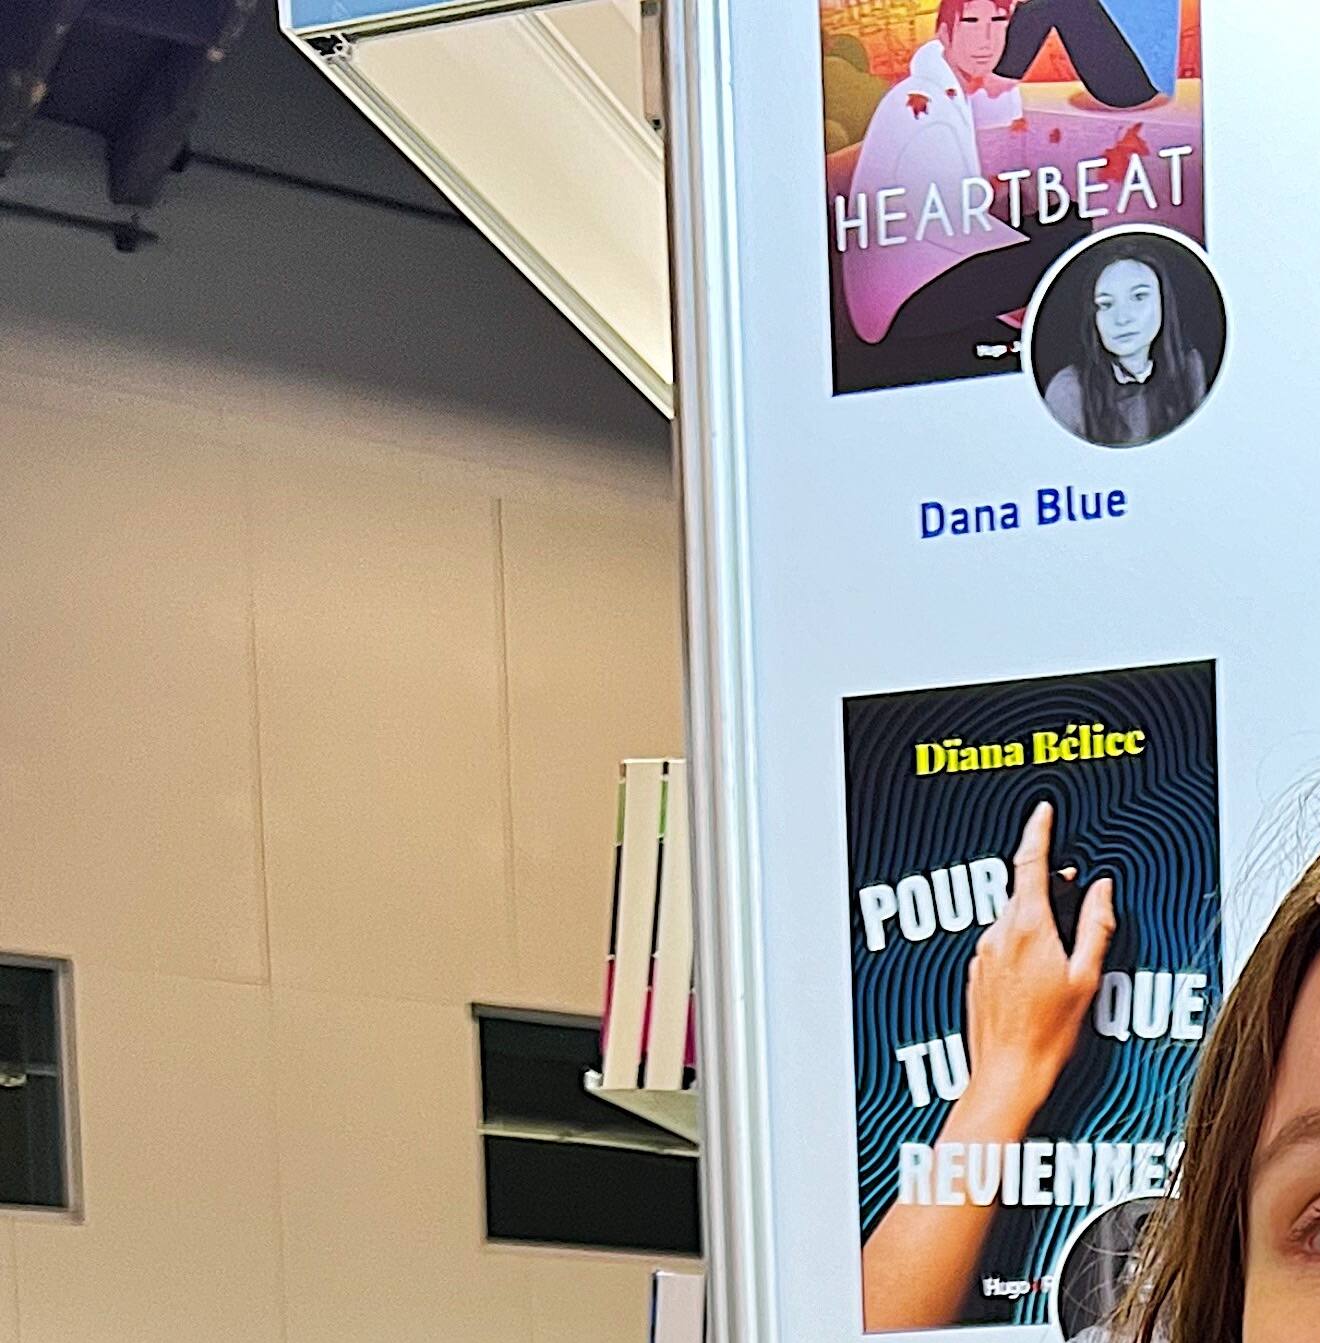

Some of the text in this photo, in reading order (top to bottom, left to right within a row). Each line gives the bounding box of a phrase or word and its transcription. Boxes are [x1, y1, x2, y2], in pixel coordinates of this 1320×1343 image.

[835, 145, 1194, 253] HEARTBEAT
[920, 486, 1129, 540] Dana Blue
[1032, 722, 1146, 764] Bélice
[858, 856, 1011, 952] POUR
[1094, 971, 1208, 1041] QUE
[896, 1033, 971, 1109] TU
